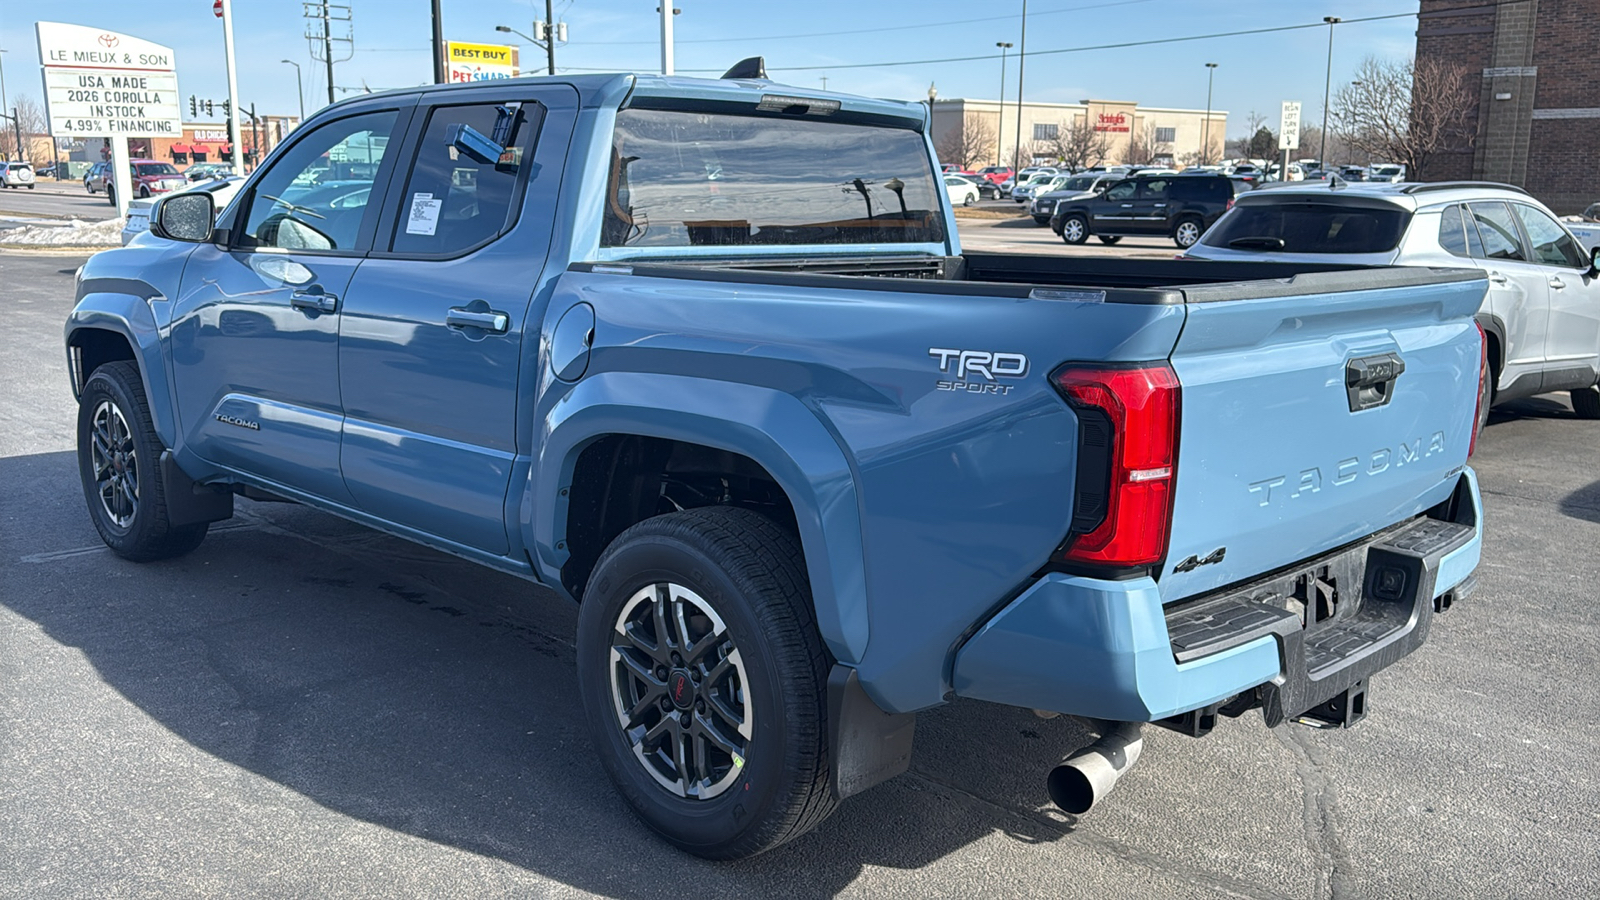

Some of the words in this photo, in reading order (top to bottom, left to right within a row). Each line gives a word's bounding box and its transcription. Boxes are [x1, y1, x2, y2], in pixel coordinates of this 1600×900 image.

[50, 50, 67, 61] LE
[74, 51, 117, 63] MIEUX
[123, 53, 132, 64] &
[139, 54, 168, 65] SON
[453, 48, 480, 58] BEST
[483, 50, 508, 60] BUY
[78, 75, 105, 88] USA
[112, 77, 147, 89] MADE
[68, 90, 99, 102] 2026
[104, 91, 161, 104] COROLLA
[64, 119, 103, 132] 4.99%
[108, 120, 172, 132] FINANCING
[194, 130, 206, 139] OLD
[206, 130, 229, 139] CHICAG
[929, 348, 1030, 383] TRD
[937, 380, 1014, 396] SPORT
[214, 413, 260, 431] TACOMA
[1248, 430, 1446, 507] TACOMA
[675, 675, 686, 702] TRD
